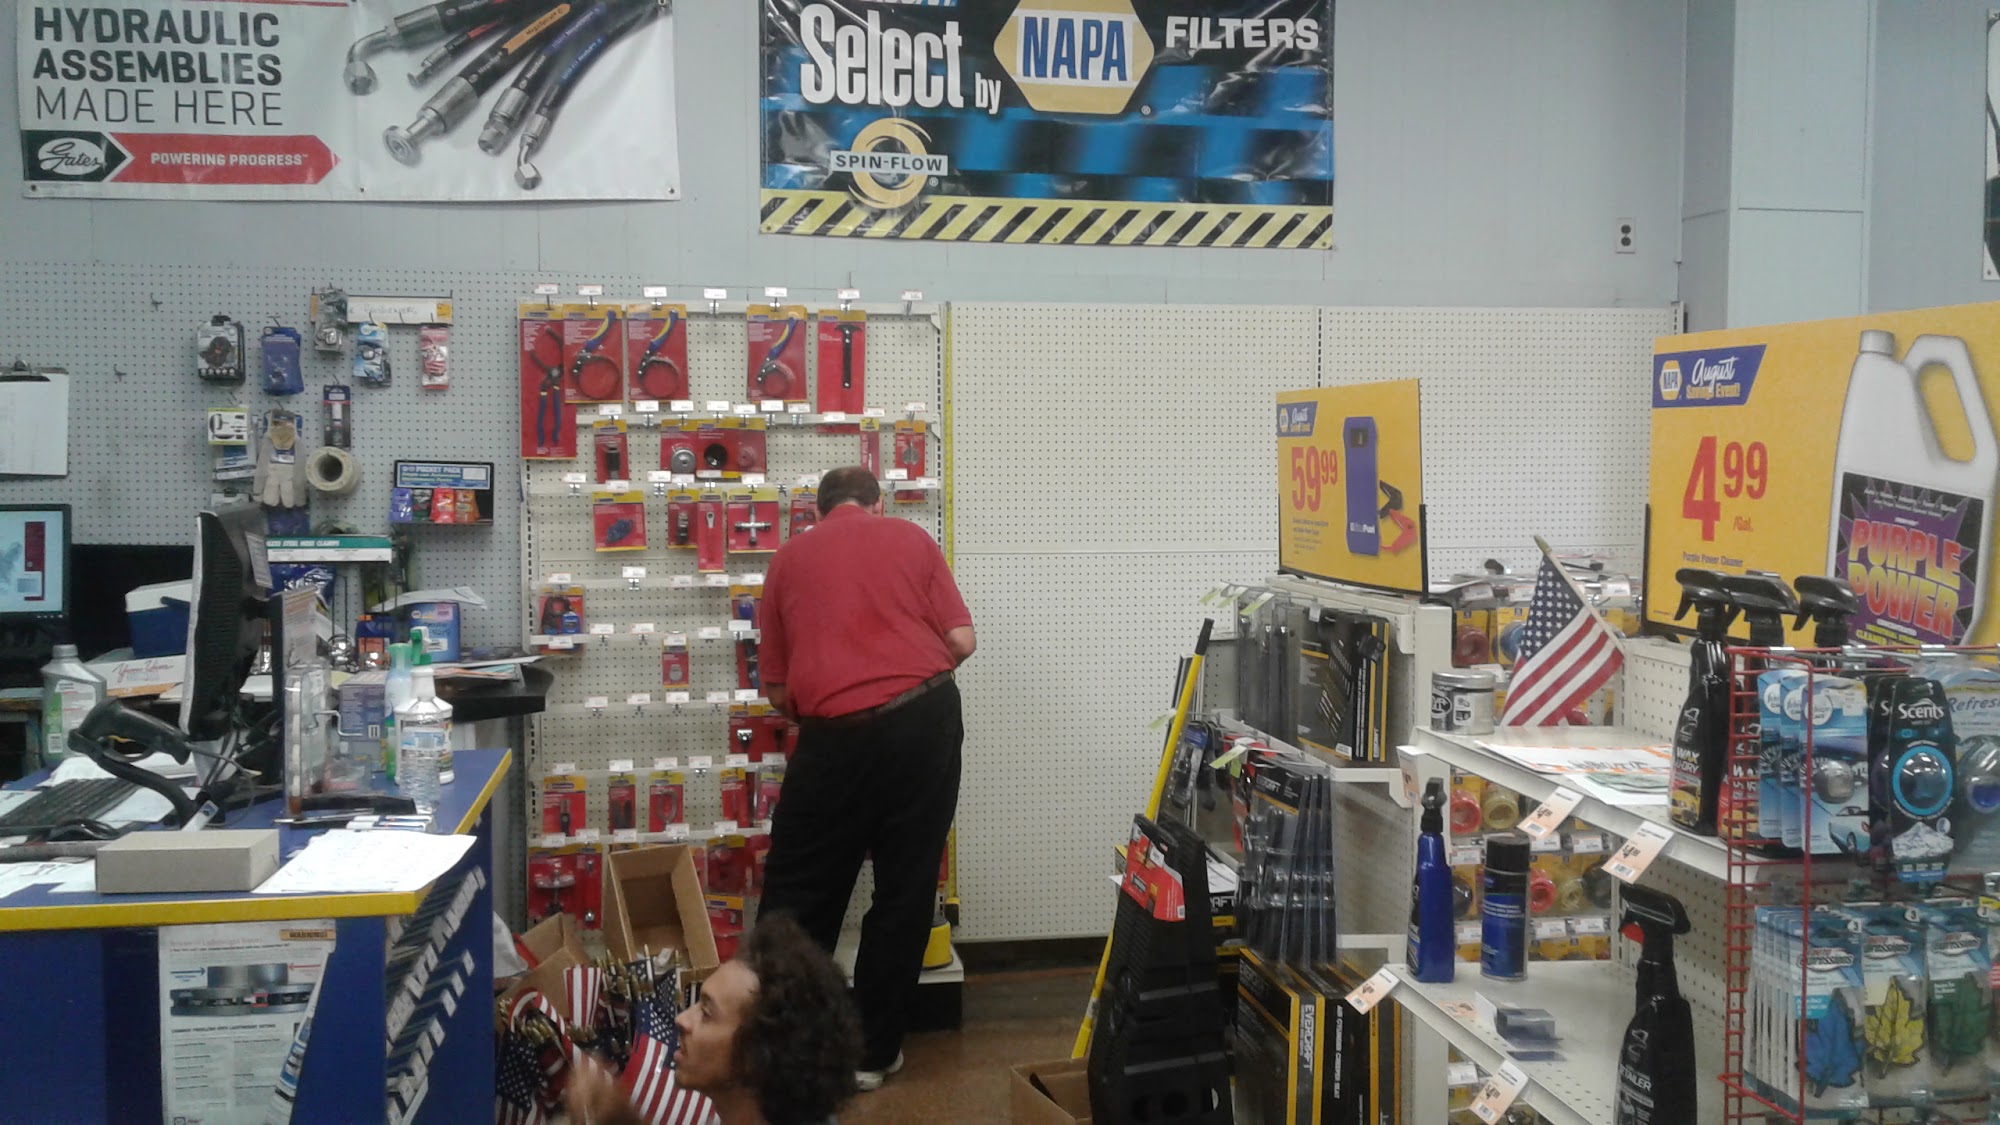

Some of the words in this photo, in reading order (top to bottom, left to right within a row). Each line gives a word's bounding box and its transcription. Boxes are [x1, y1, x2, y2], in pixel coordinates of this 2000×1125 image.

[34, 7, 280, 47] HYDRAULIC
[1165, 15, 1319, 50] FILTERS
[33, 47, 282, 86] ASSEMBLIES
[800, 3, 964, 108] Select
[974, 72, 1001, 115] by
[1023, 16, 1128, 82] NAPA
[36, 85, 156, 124] MADE
[174, 89, 284, 126] HERE
[40, 141, 103, 172] Gates
[150, 152, 226, 166] POWERING
[229, 153, 302, 167] PROGRESS
[835, 154, 943, 172] SPIN-FLOW
[1662, 369, 1679, 391] NAPA
[1686, 383, 1716, 400] Savings
[1715, 381, 1741, 399] Event!
[1691, 355, 1740, 391] August
[1848, 518, 1962, 590] PURPLE
[1847, 562, 1960, 640] POWER
[1897, 702, 1945, 720] Scents
[1676, 746, 1700, 762] WAX
[1619, 1063, 1652, 1092] ETAILER
